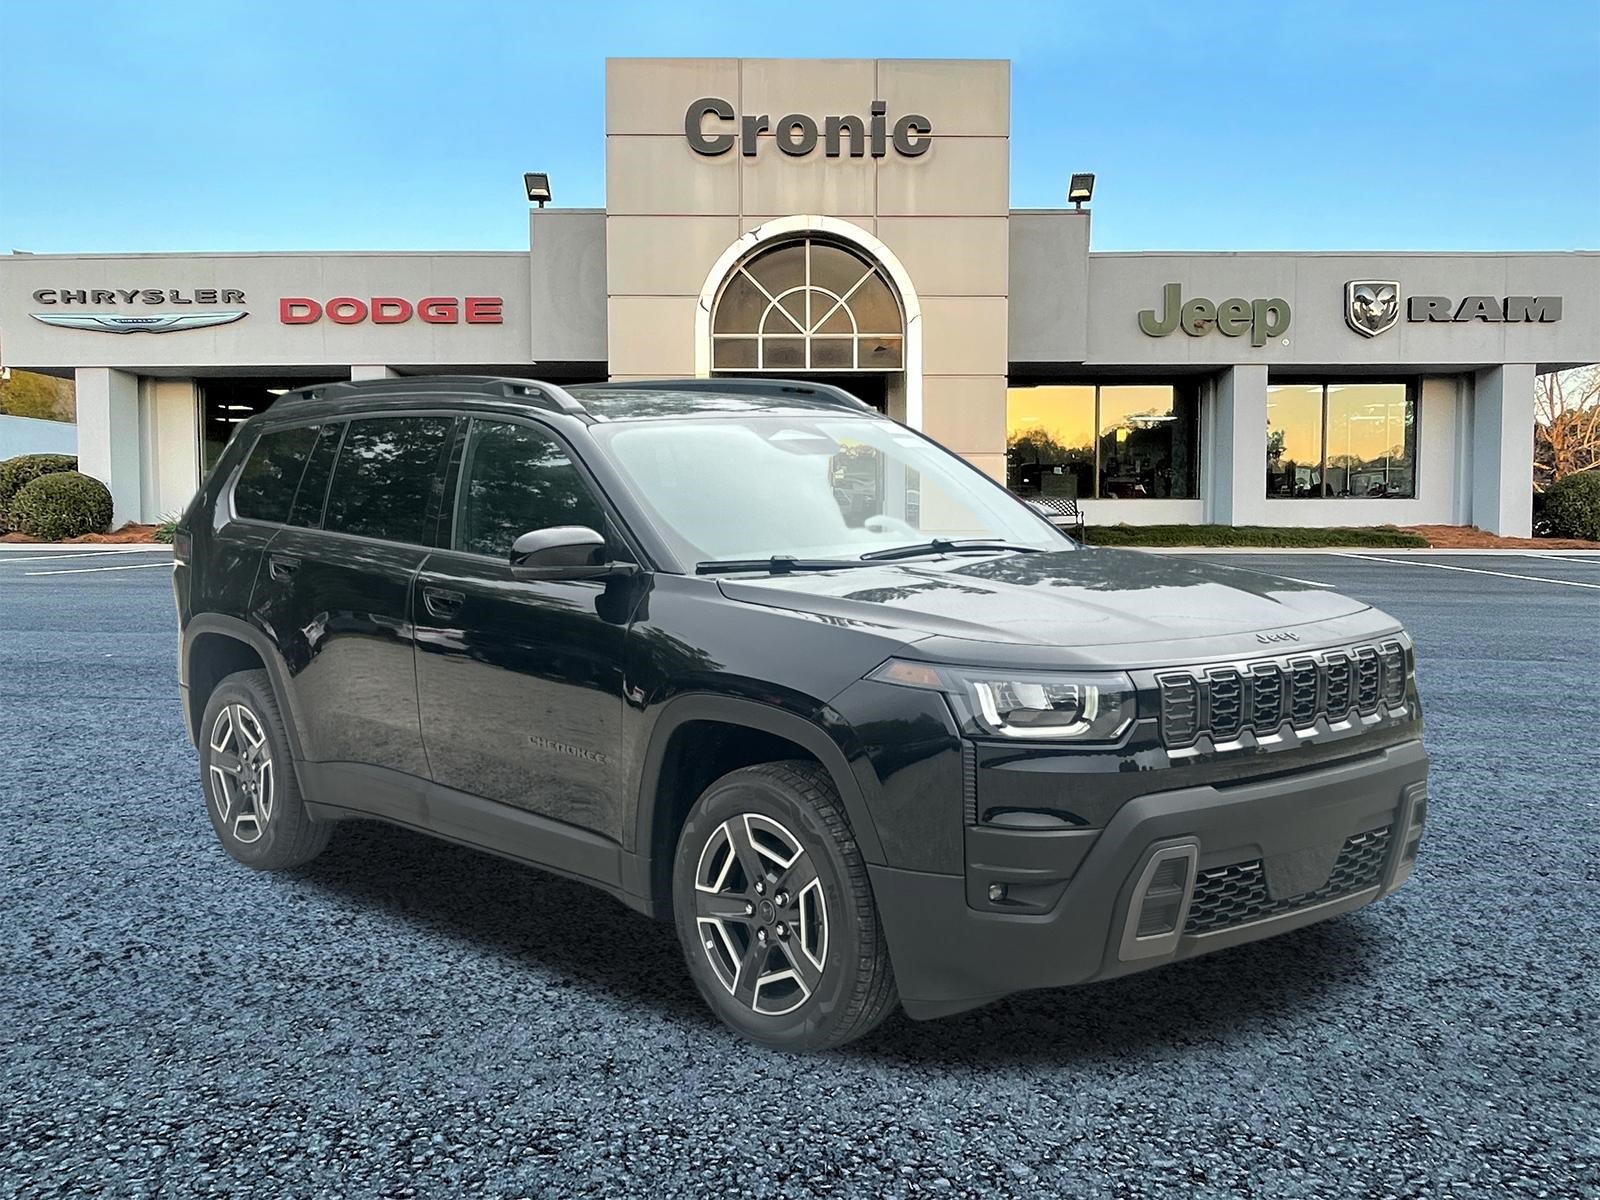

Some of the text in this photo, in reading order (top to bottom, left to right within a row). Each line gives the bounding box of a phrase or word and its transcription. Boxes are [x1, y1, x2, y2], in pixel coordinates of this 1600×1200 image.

[685, 96, 932, 158] Cronic
[32, 288, 247, 306] CHRYSLER
[279, 296, 504, 325] DODGE
[1407, 295, 1563, 323] RAM
[1138, 282, 1291, 347] Jeep
[1256, 630, 1300, 645] Jeep
[528, 735, 608, 764] CHEROKEE
